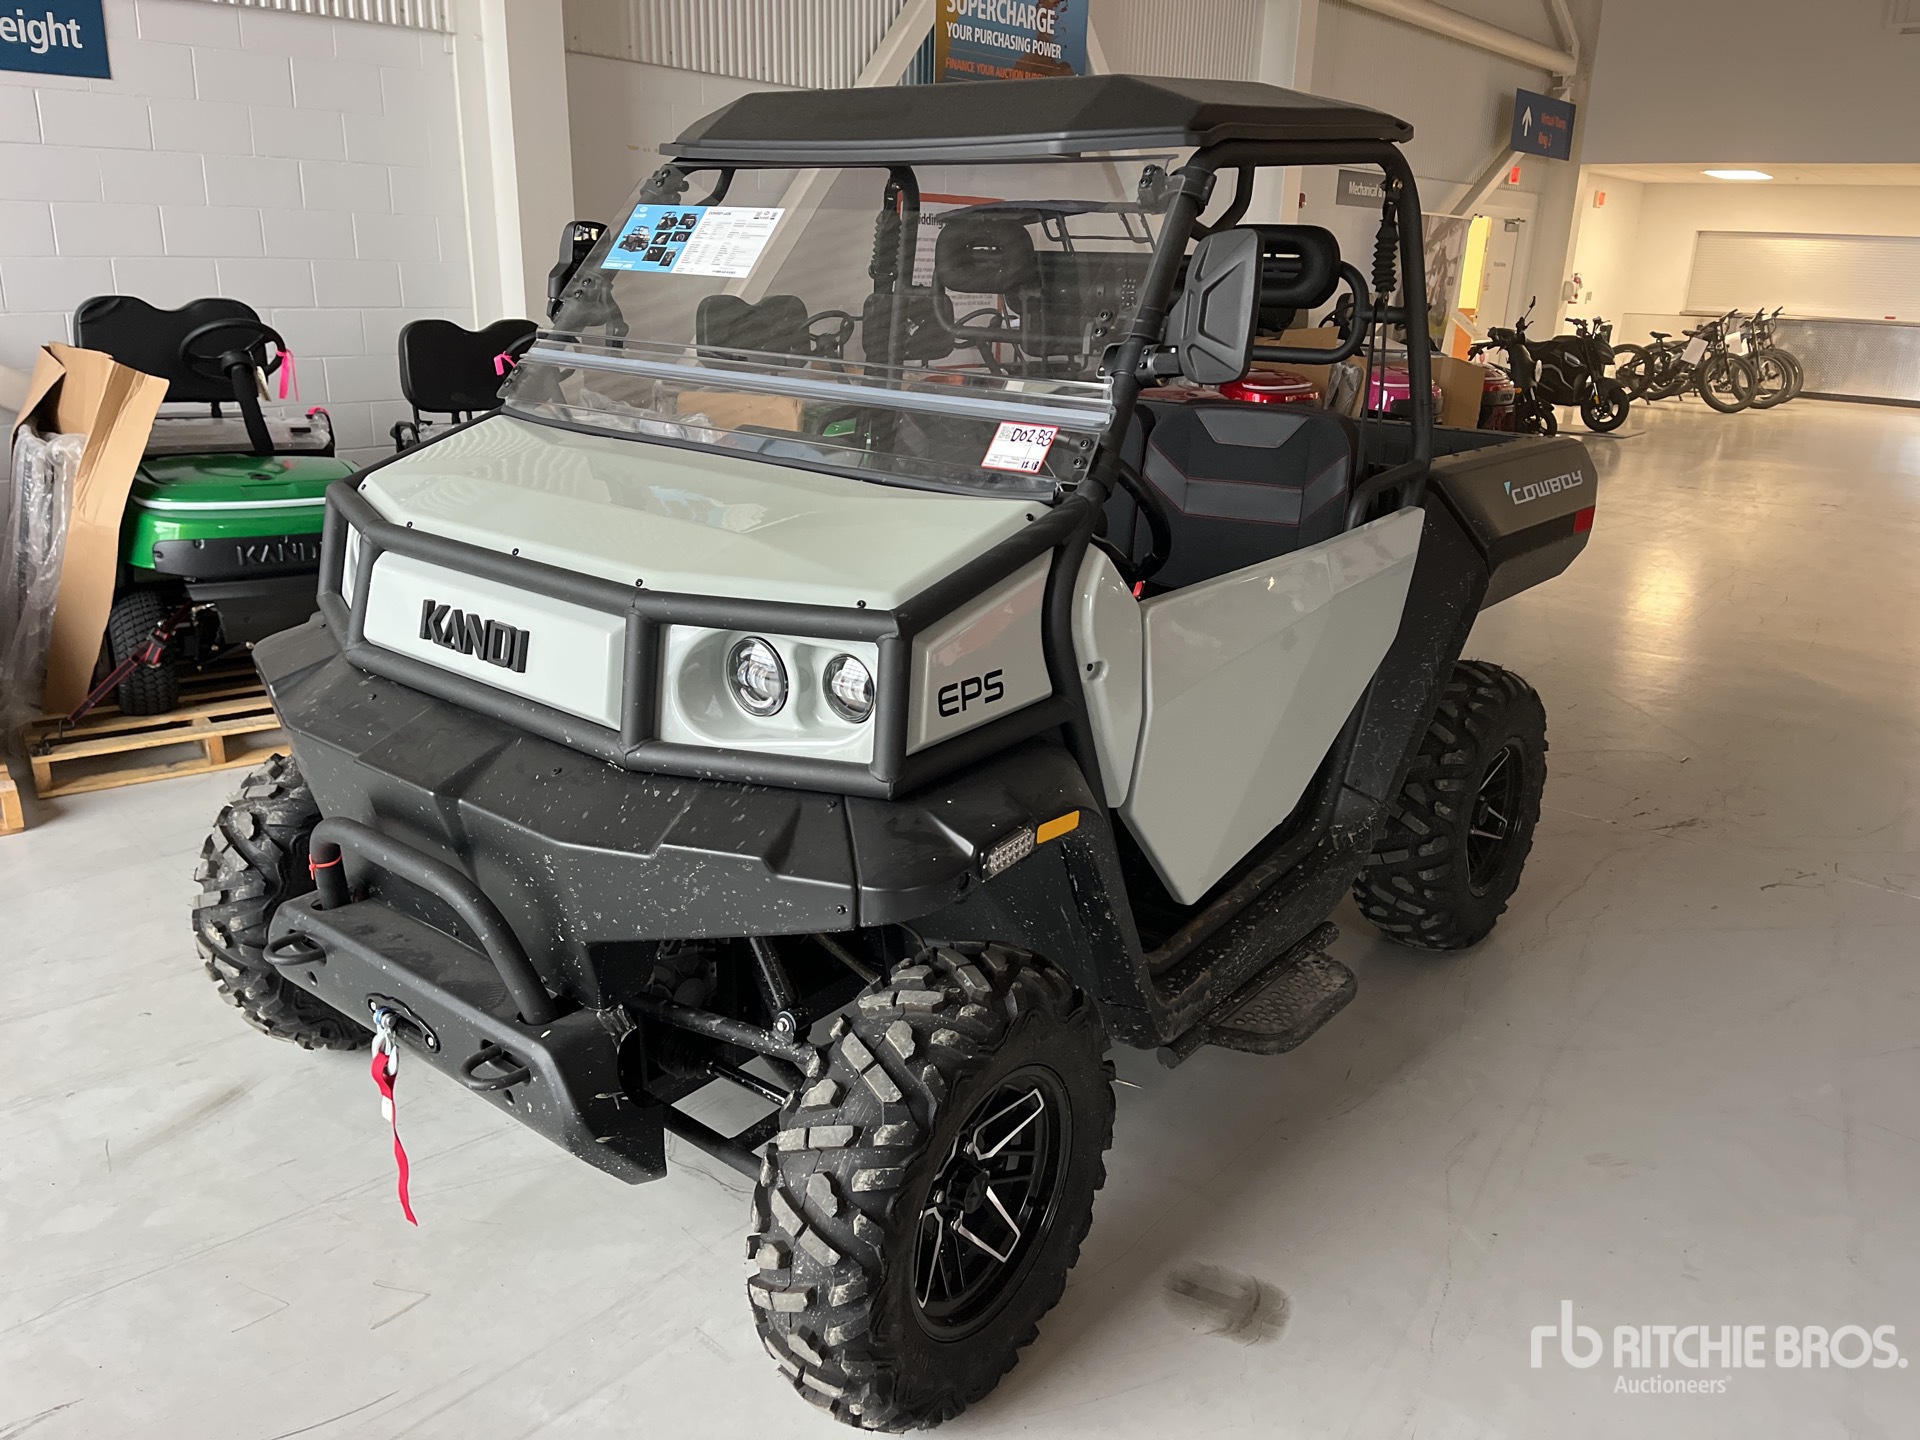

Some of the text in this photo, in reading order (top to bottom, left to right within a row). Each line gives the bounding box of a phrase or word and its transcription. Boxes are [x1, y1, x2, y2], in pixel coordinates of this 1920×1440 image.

[946, 0, 1056, 35] SUPERCHARGE
[946, 21, 1062, 59] YOUR PURCHASING POWER
[946, 57, 976, 74] FINANCE
[976, 63, 995, 76] YOUR
[996, 66, 1024, 79] AUCTION
[1349, 181, 1378, 197] Mechanical
[1512, 470, 1583, 505] COWBOY
[237, 542, 322, 565] KAND
[419, 599, 530, 673] KANDI
[938, 669, 1004, 717] EPS
